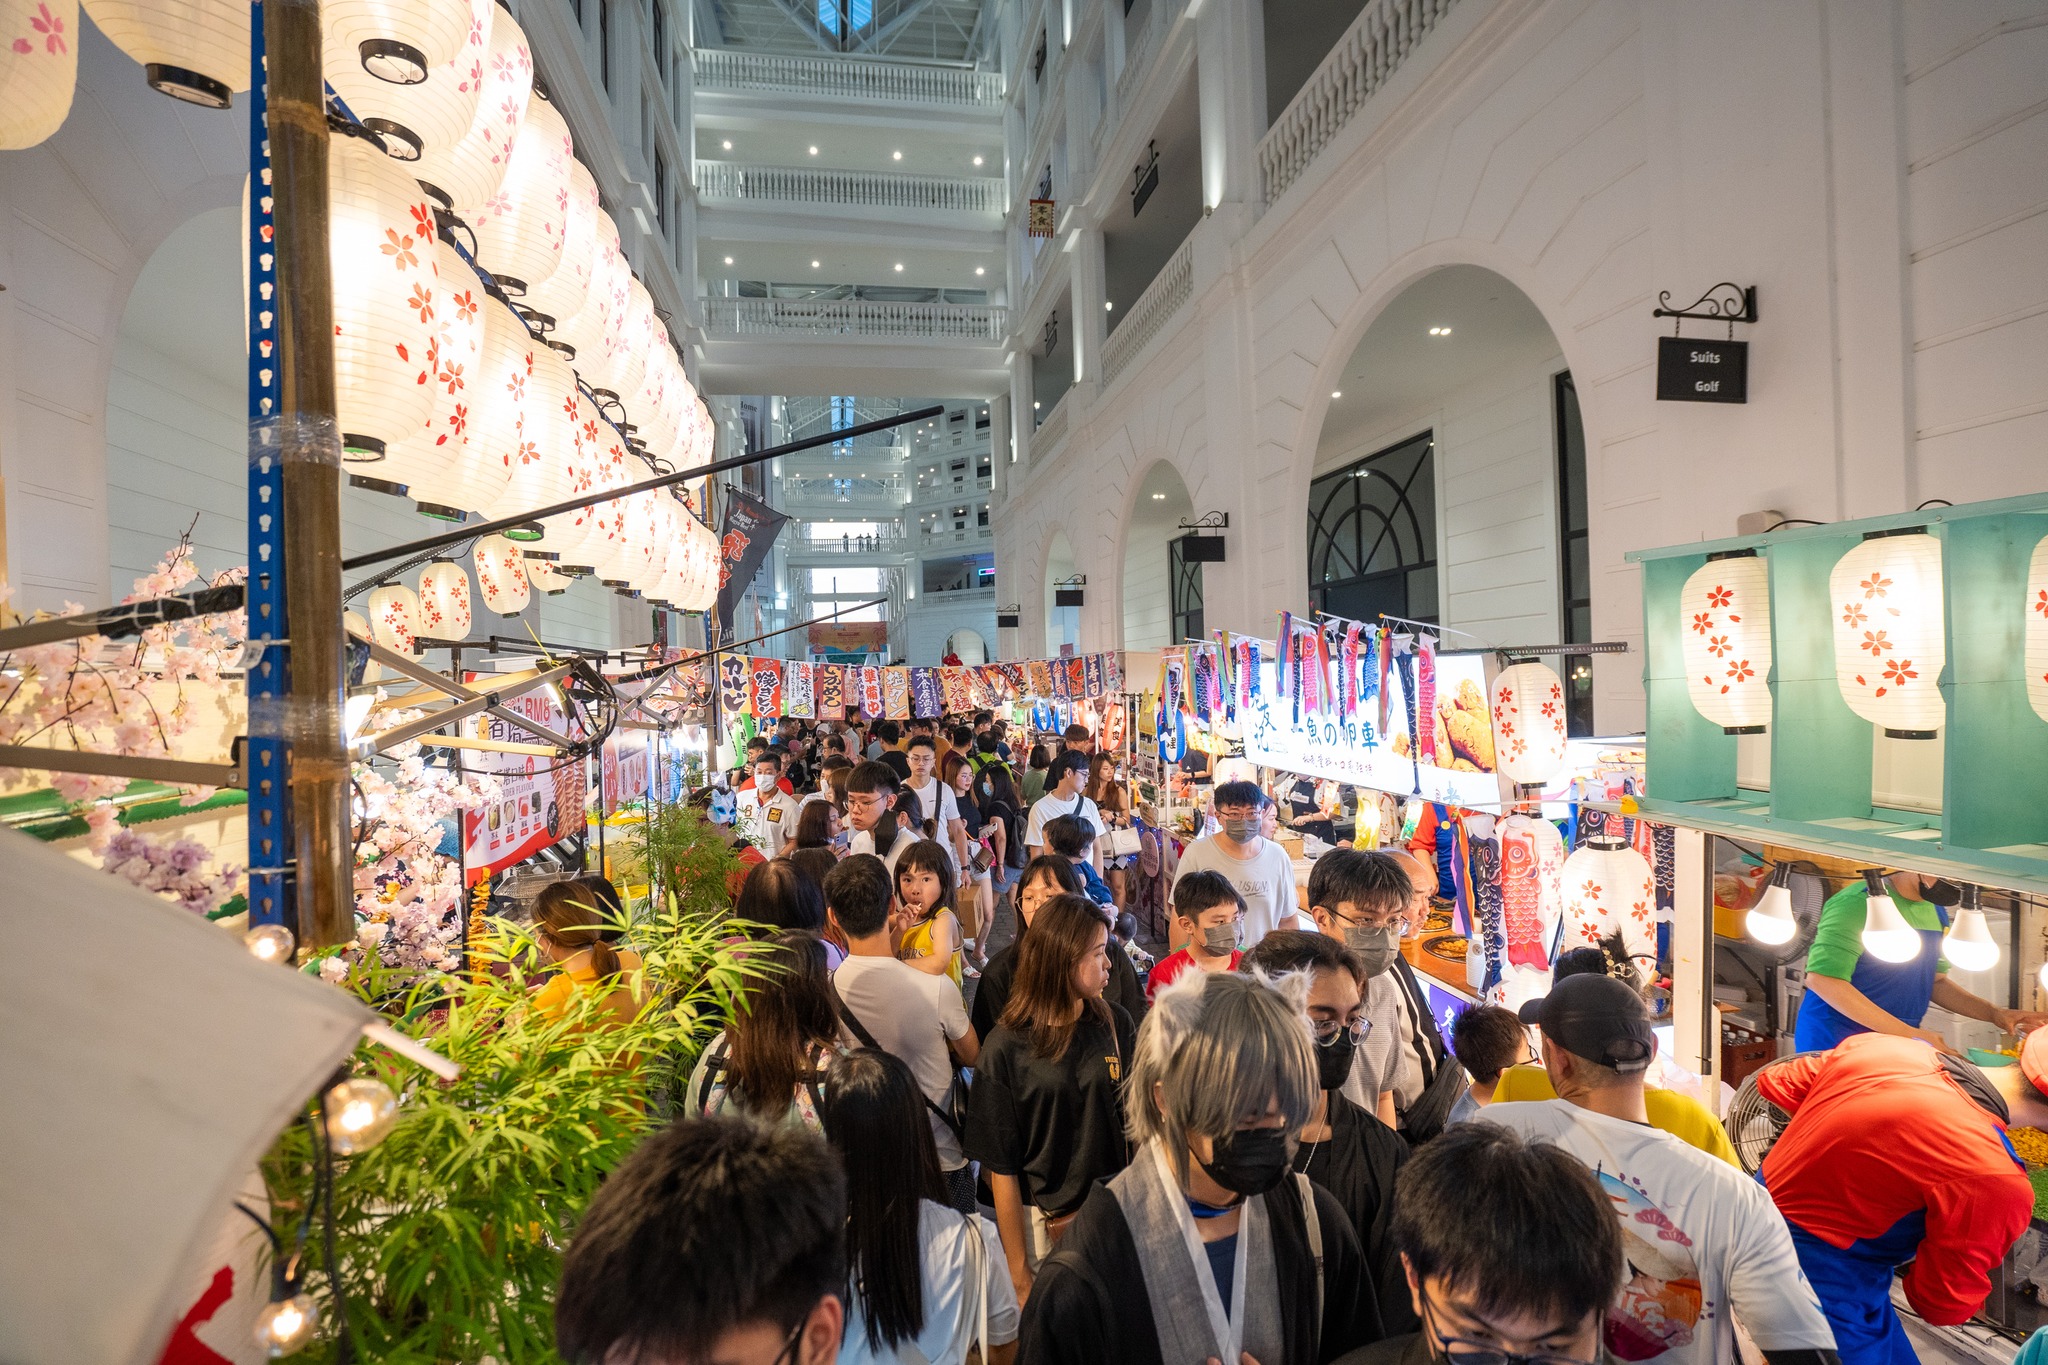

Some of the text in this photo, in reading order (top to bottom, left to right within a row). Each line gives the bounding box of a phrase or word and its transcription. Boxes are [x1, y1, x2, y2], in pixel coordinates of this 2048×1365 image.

[1690, 351, 1721, 364] Suits
[1694, 380, 1720, 393] Golf
[733, 509, 753, 525] Japan
[721, 655, 747, 712] カルビ
[822, 664, 842, 708] いかめし
[863, 668, 880, 715] 準備中
